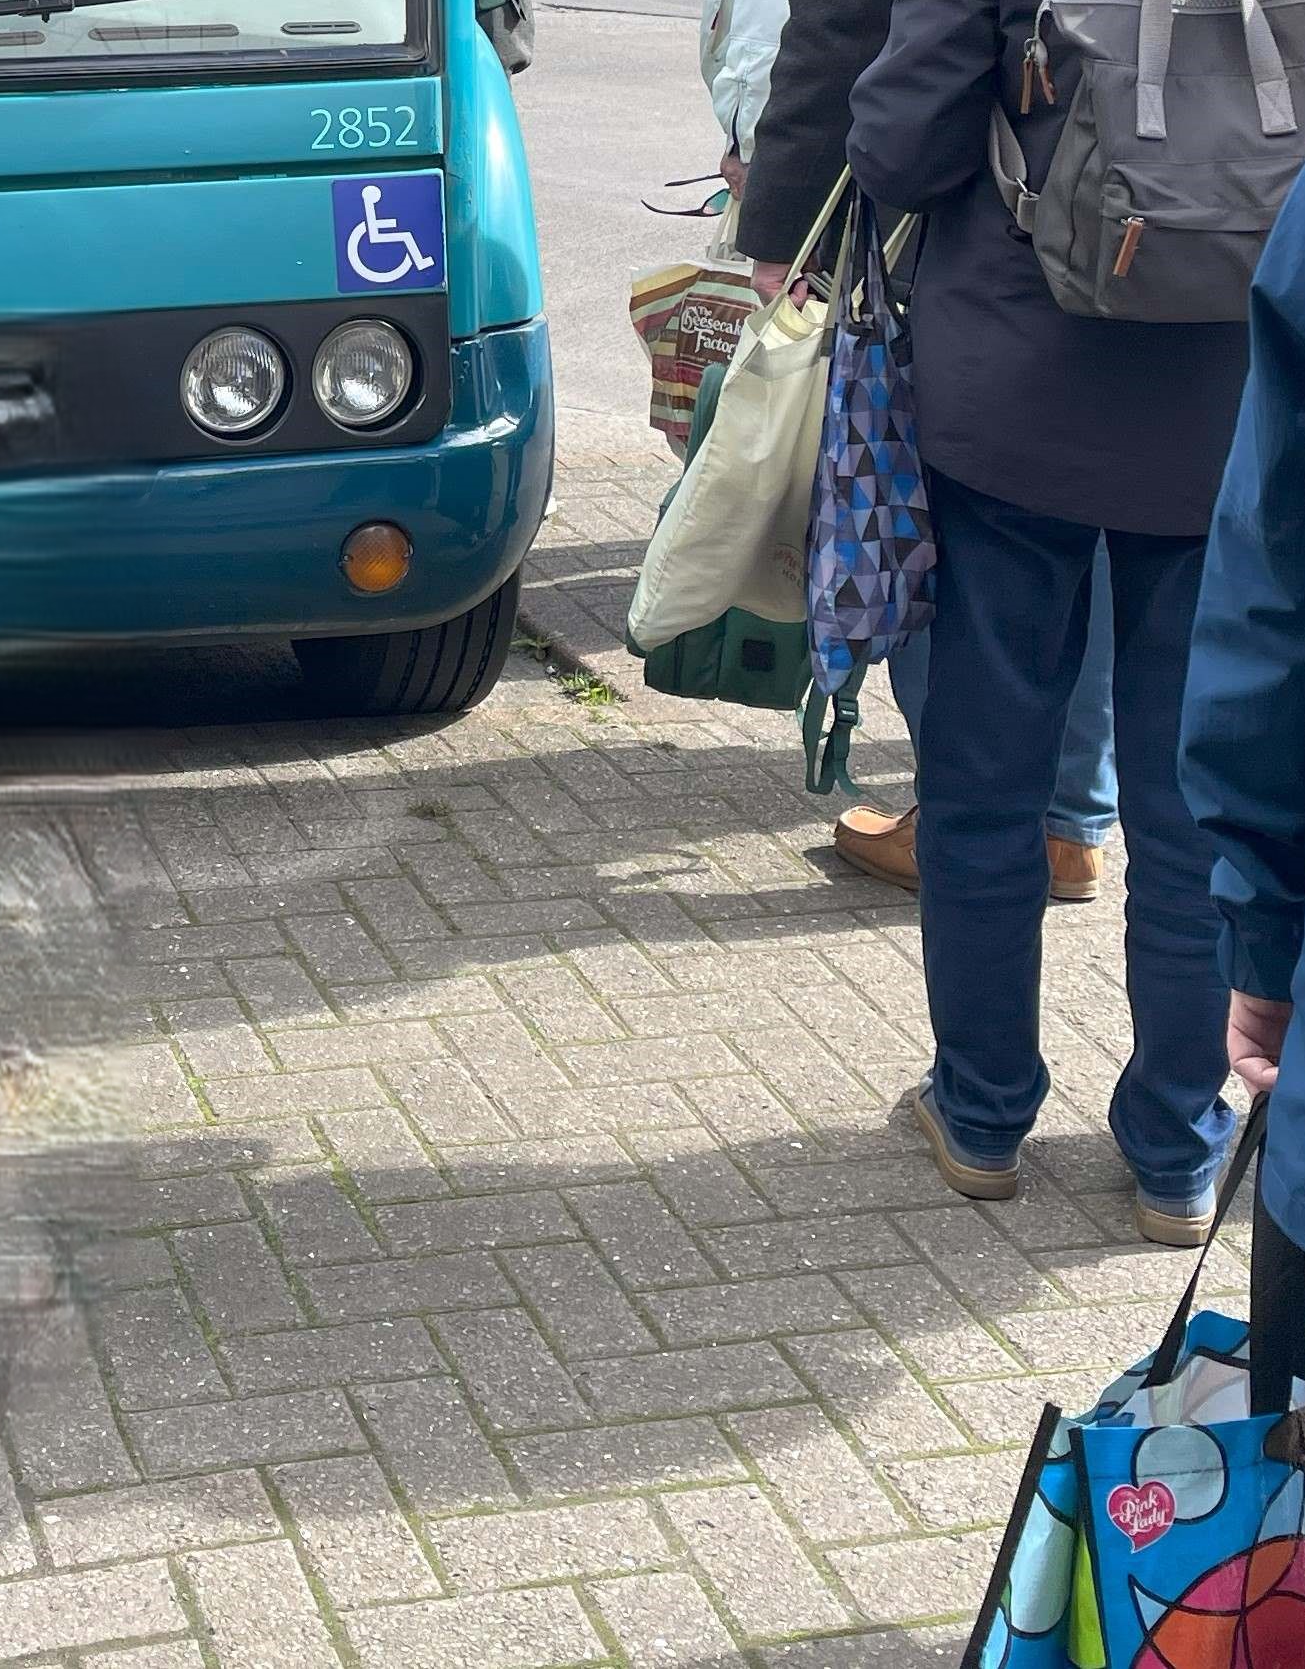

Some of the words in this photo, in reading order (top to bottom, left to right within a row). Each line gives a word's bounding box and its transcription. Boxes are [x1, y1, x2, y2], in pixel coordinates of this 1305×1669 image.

[310, 105, 418, 150] 2852
[681, 306, 742, 336] Cheesecak
[697, 305, 713, 317] The
[1112, 1490, 1159, 1524] Pink
[1128, 1507, 1171, 1536] Lady
